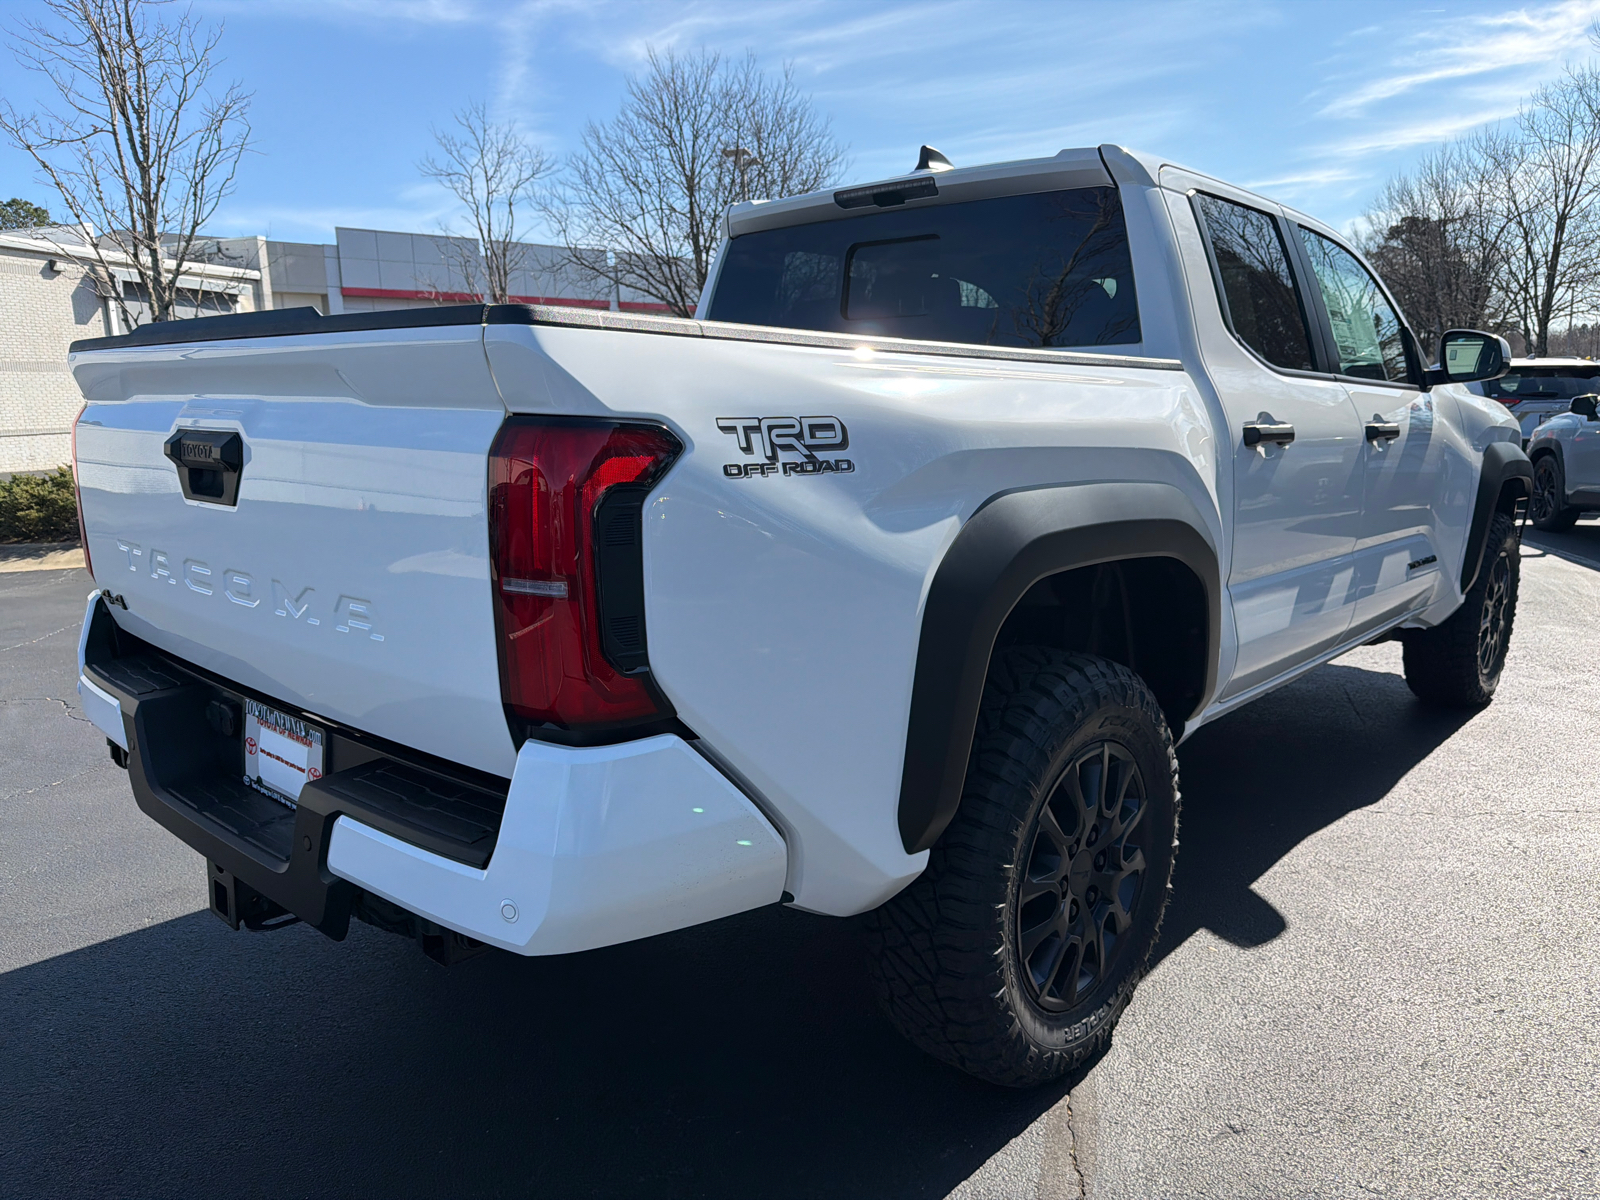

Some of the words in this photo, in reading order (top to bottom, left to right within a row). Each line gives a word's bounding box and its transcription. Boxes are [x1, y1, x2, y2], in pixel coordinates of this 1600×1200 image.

[181, 443, 213, 459] TOYOTA
[715, 415, 850, 463] TRD
[722, 462, 779, 480] OFF
[782, 459, 856, 478] ROAD
[116, 538, 385, 641] TACOMA
